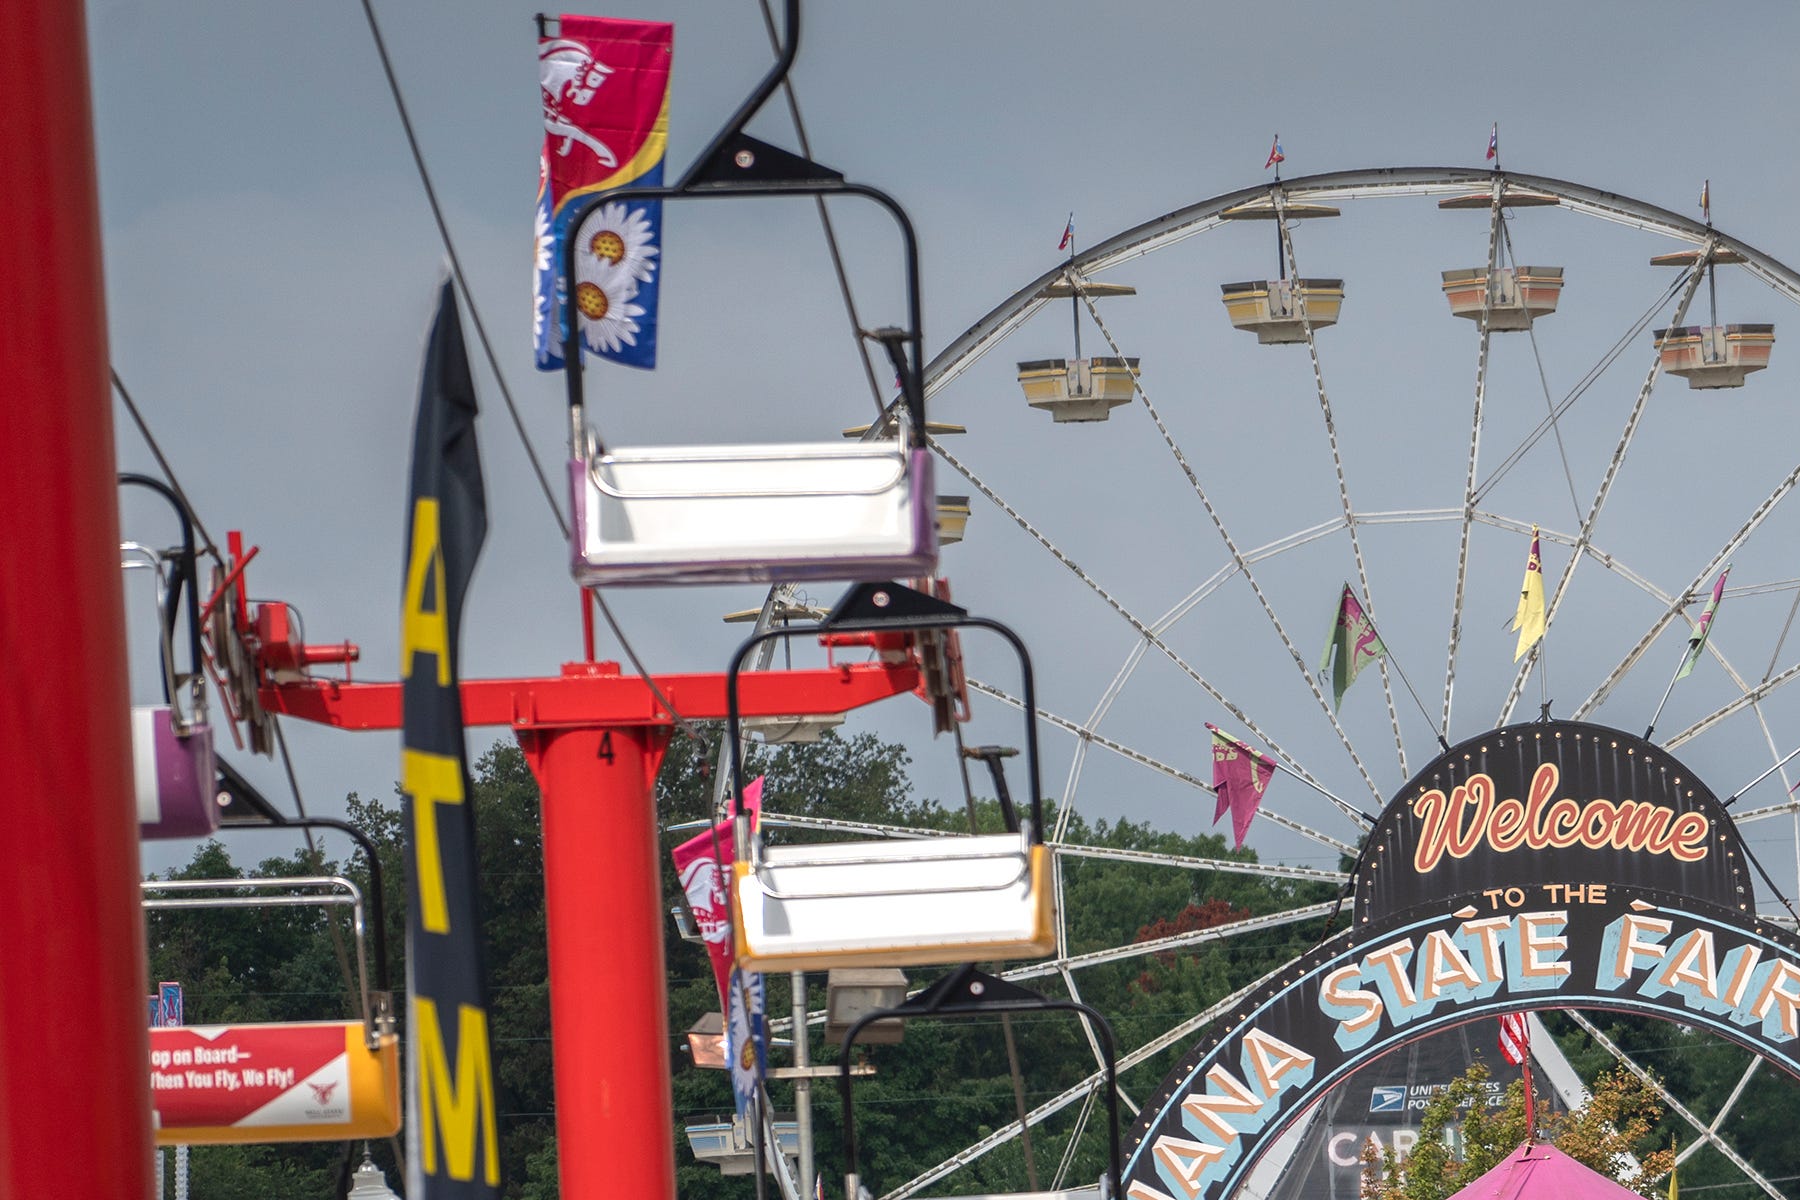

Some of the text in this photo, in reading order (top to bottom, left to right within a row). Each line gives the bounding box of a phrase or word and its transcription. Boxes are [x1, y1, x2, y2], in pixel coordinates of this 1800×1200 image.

[596, 730, 616, 766] 4
[1413, 762, 1710, 873] Welcome
[401, 496, 500, 1187] ATM
[1484, 884, 1608, 909] TO THE
[1318, 910, 1572, 1052] STATE
[149, 1052, 171, 1069] op
[173, 1050, 193, 1066] on
[186, 1071, 213, 1088] You
[243, 1068, 265, 1086] We
[267, 1067, 294, 1089] Fly!
